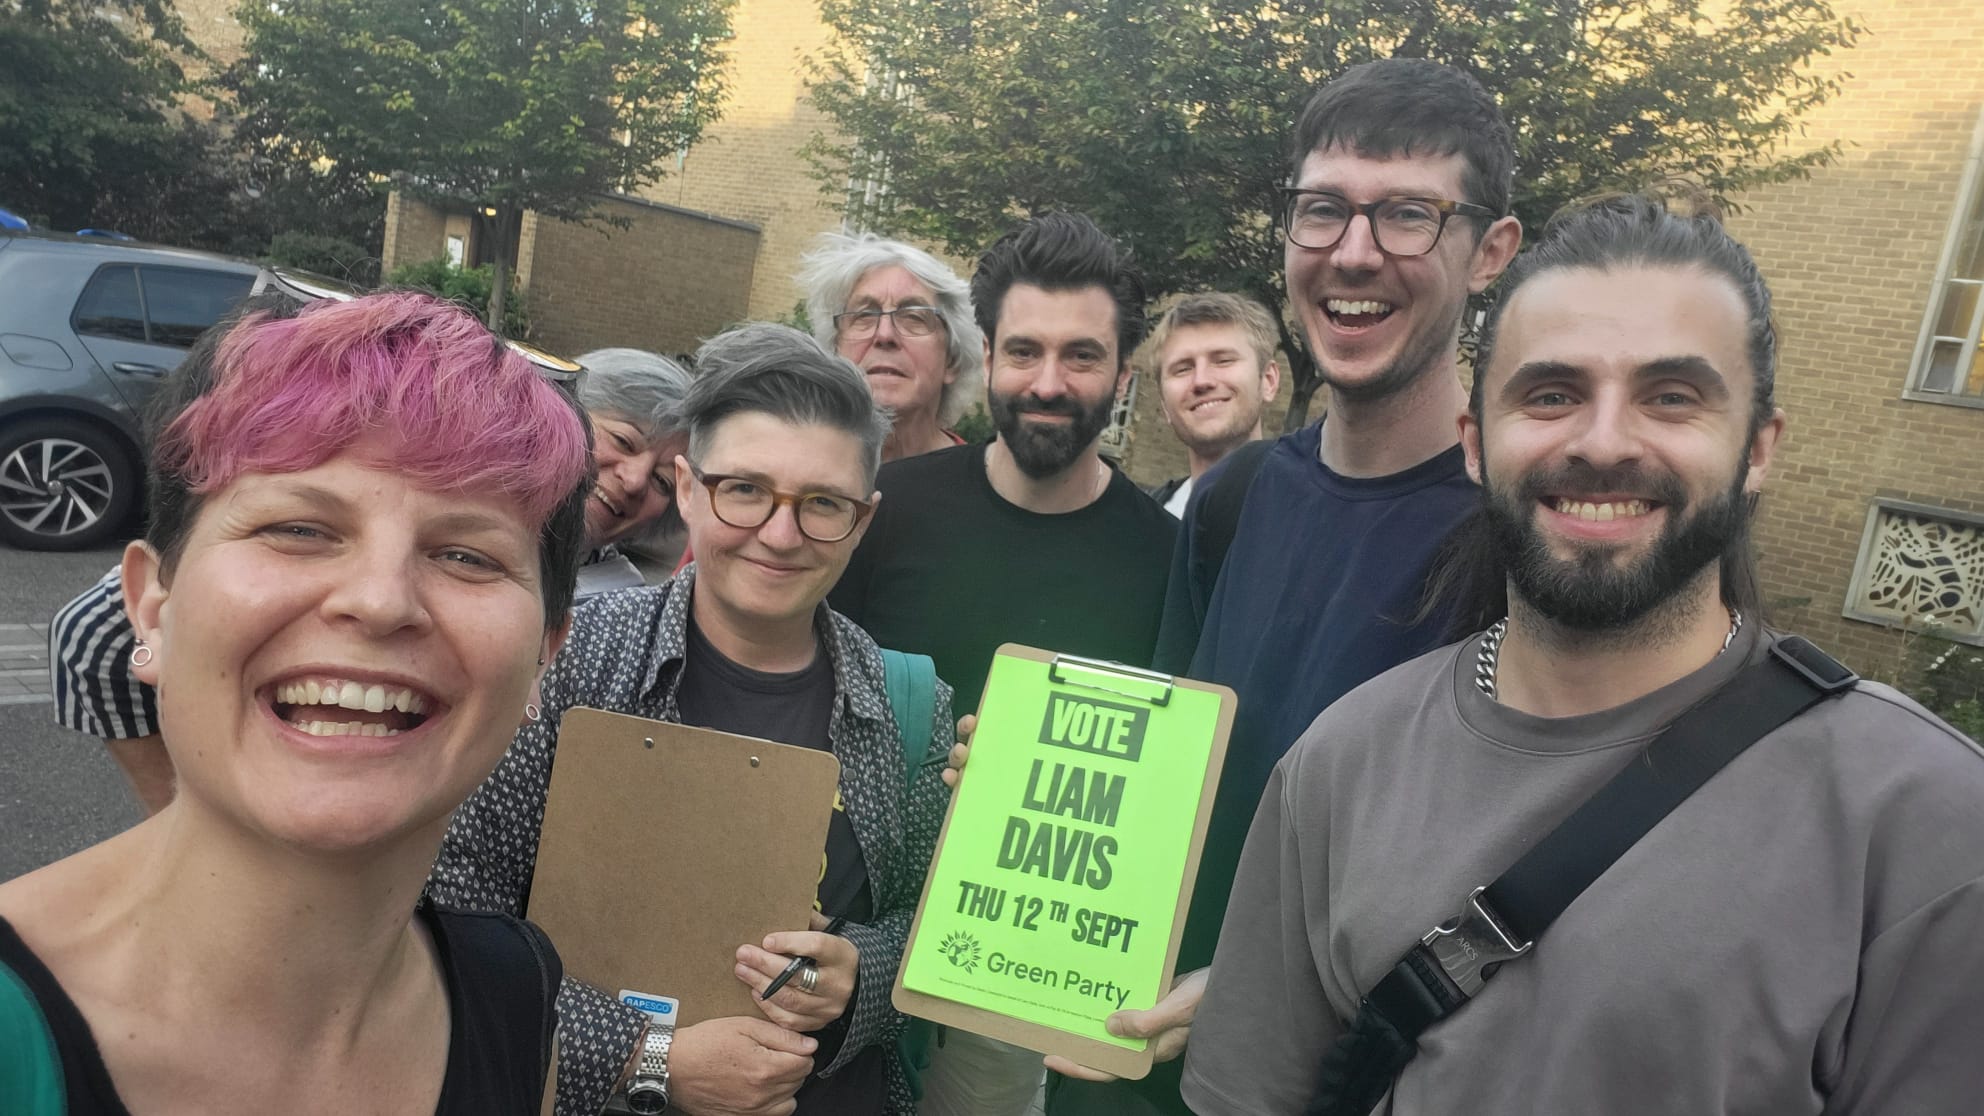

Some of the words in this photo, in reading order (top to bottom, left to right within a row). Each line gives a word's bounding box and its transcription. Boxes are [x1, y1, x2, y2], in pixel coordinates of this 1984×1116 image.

[1050, 699, 1136, 753] VOTE
[1021, 759, 1127, 828] LIAM
[997, 816, 1118, 890] DAVIS
[956, 881, 1008, 922] THU
[1013, 895, 1043, 932] 12
[1050, 900, 1070, 923] TH
[1071, 908, 1139, 953] SEPT
[1456, 937, 1478, 961] ARCS
[987, 952, 1058, 987] Green
[1064, 969, 1131, 1010] Party
